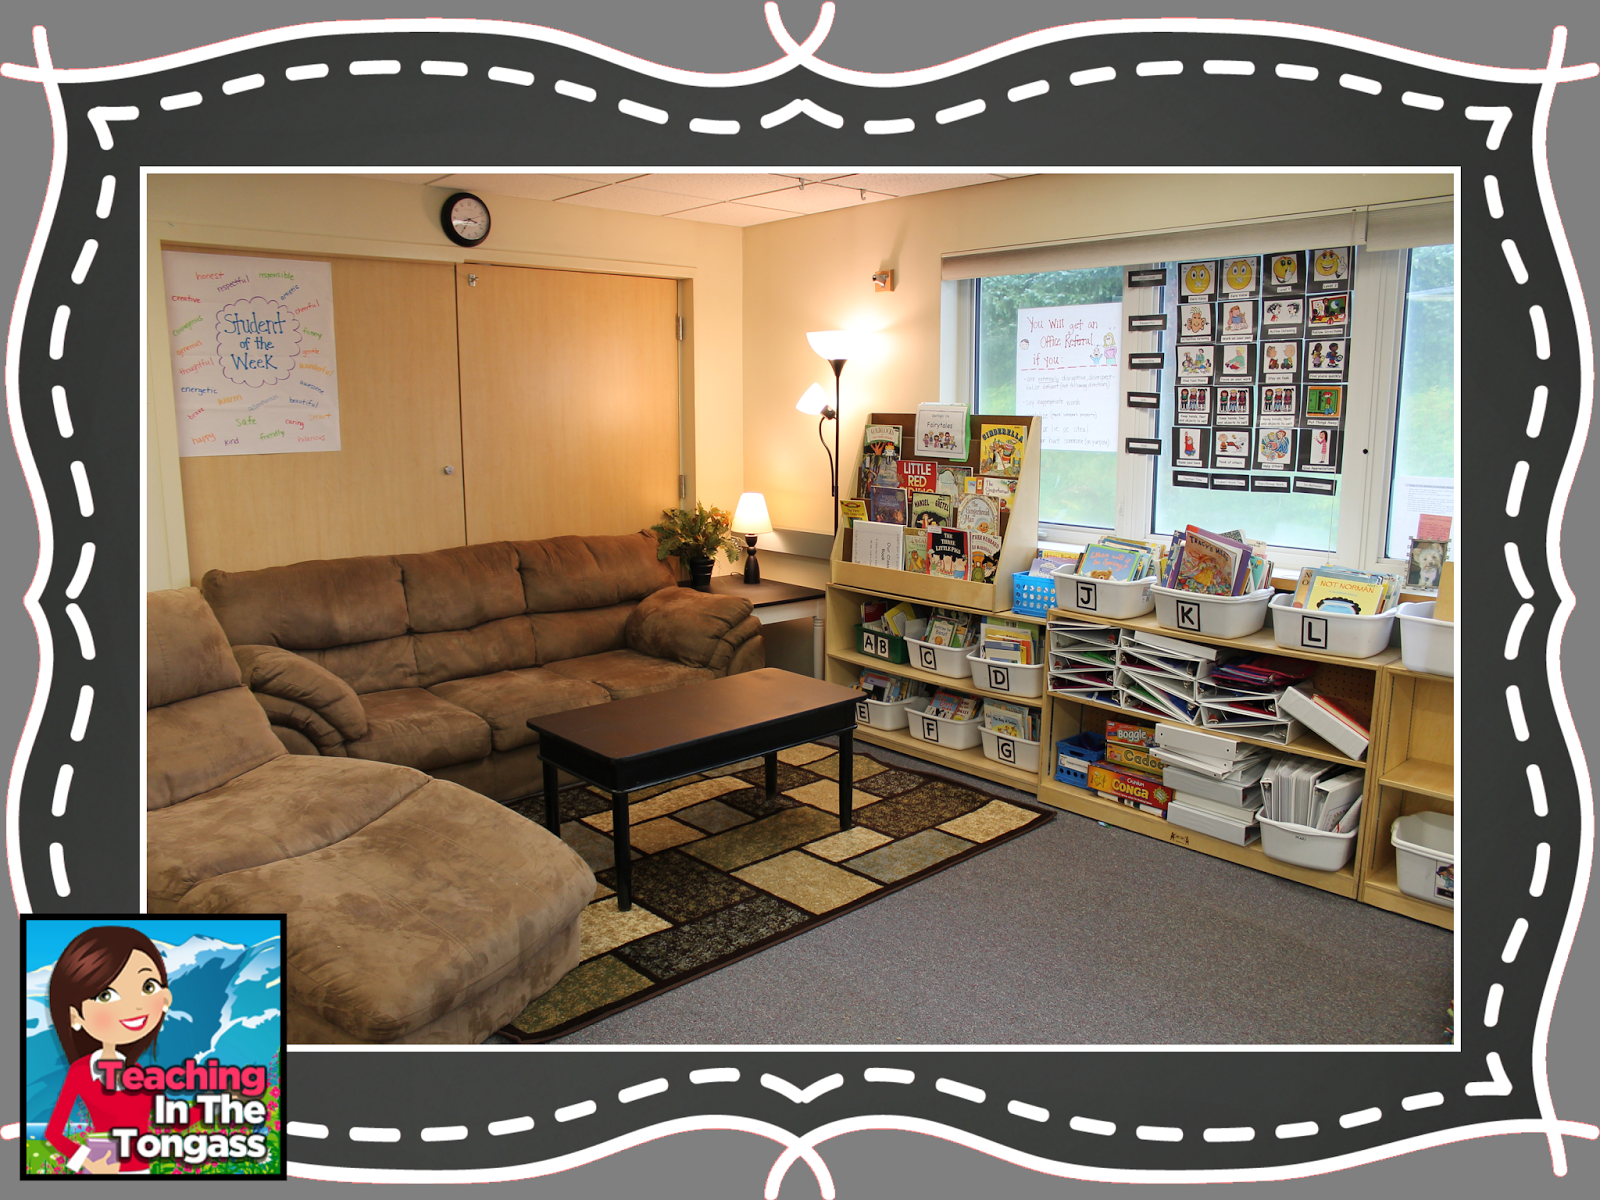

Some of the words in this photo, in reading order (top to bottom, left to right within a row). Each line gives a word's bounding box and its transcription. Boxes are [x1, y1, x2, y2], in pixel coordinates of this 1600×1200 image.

[195, 271, 225, 280] honest
[259, 271, 294, 281] responsible
[217, 274, 250, 293] respectful
[172, 295, 200, 303] creative
[280, 284, 300, 301] artistic
[295, 299, 320, 315] cheerful
[224, 312, 286, 335] Student
[1026, 316, 1044, 333] You
[1069, 319, 1084, 333] get
[302, 327, 323, 340] funny
[1040, 335, 1062, 349] Office
[1064, 332, 1094, 349] Referral
[176, 340, 203, 358] generous
[239, 337, 250, 350] of
[254, 336, 274, 350] the
[179, 357, 215, 375] thoughtful
[231, 352, 278, 370] Week
[1033, 352, 1040, 366] if
[299, 362, 335, 377] wonderful
[180, 386, 218, 396] energetic
[299, 380, 325, 395] awesome
[217, 394, 243, 405] warm
[289, 396, 319, 409] beautiful
[187, 407, 205, 420] brave
[285, 418, 305, 430] caring
[191, 433, 216, 445] happy
[259, 429, 285, 442] friendly
[982, 427, 1024, 443] CINDERELLA
[903, 462, 932, 476] LITTLE
[908, 475, 927, 487] RED
[961, 514, 975, 525] Man
[1189, 535, 1214, 553] TRACY'S
[1102, 558, 1128, 572] Spring?
[1339, 580, 1375, 594] NORMAN
[1080, 586, 1093, 605] J
[1181, 605, 1194, 625] K
[1307, 621, 1322, 642] L
[865, 635, 873, 650] A
[879, 640, 887, 654] B
[924, 651, 933, 665] C
[992, 670, 1006, 685] D
[858, 705, 867, 719] E
[926, 722, 935, 736] F
[1117, 728, 1147, 743] Boggle
[1001, 743, 1012, 758] G
[1123, 749, 1165, 770] Cadoo
[1126, 777, 1145, 787] Cranium
